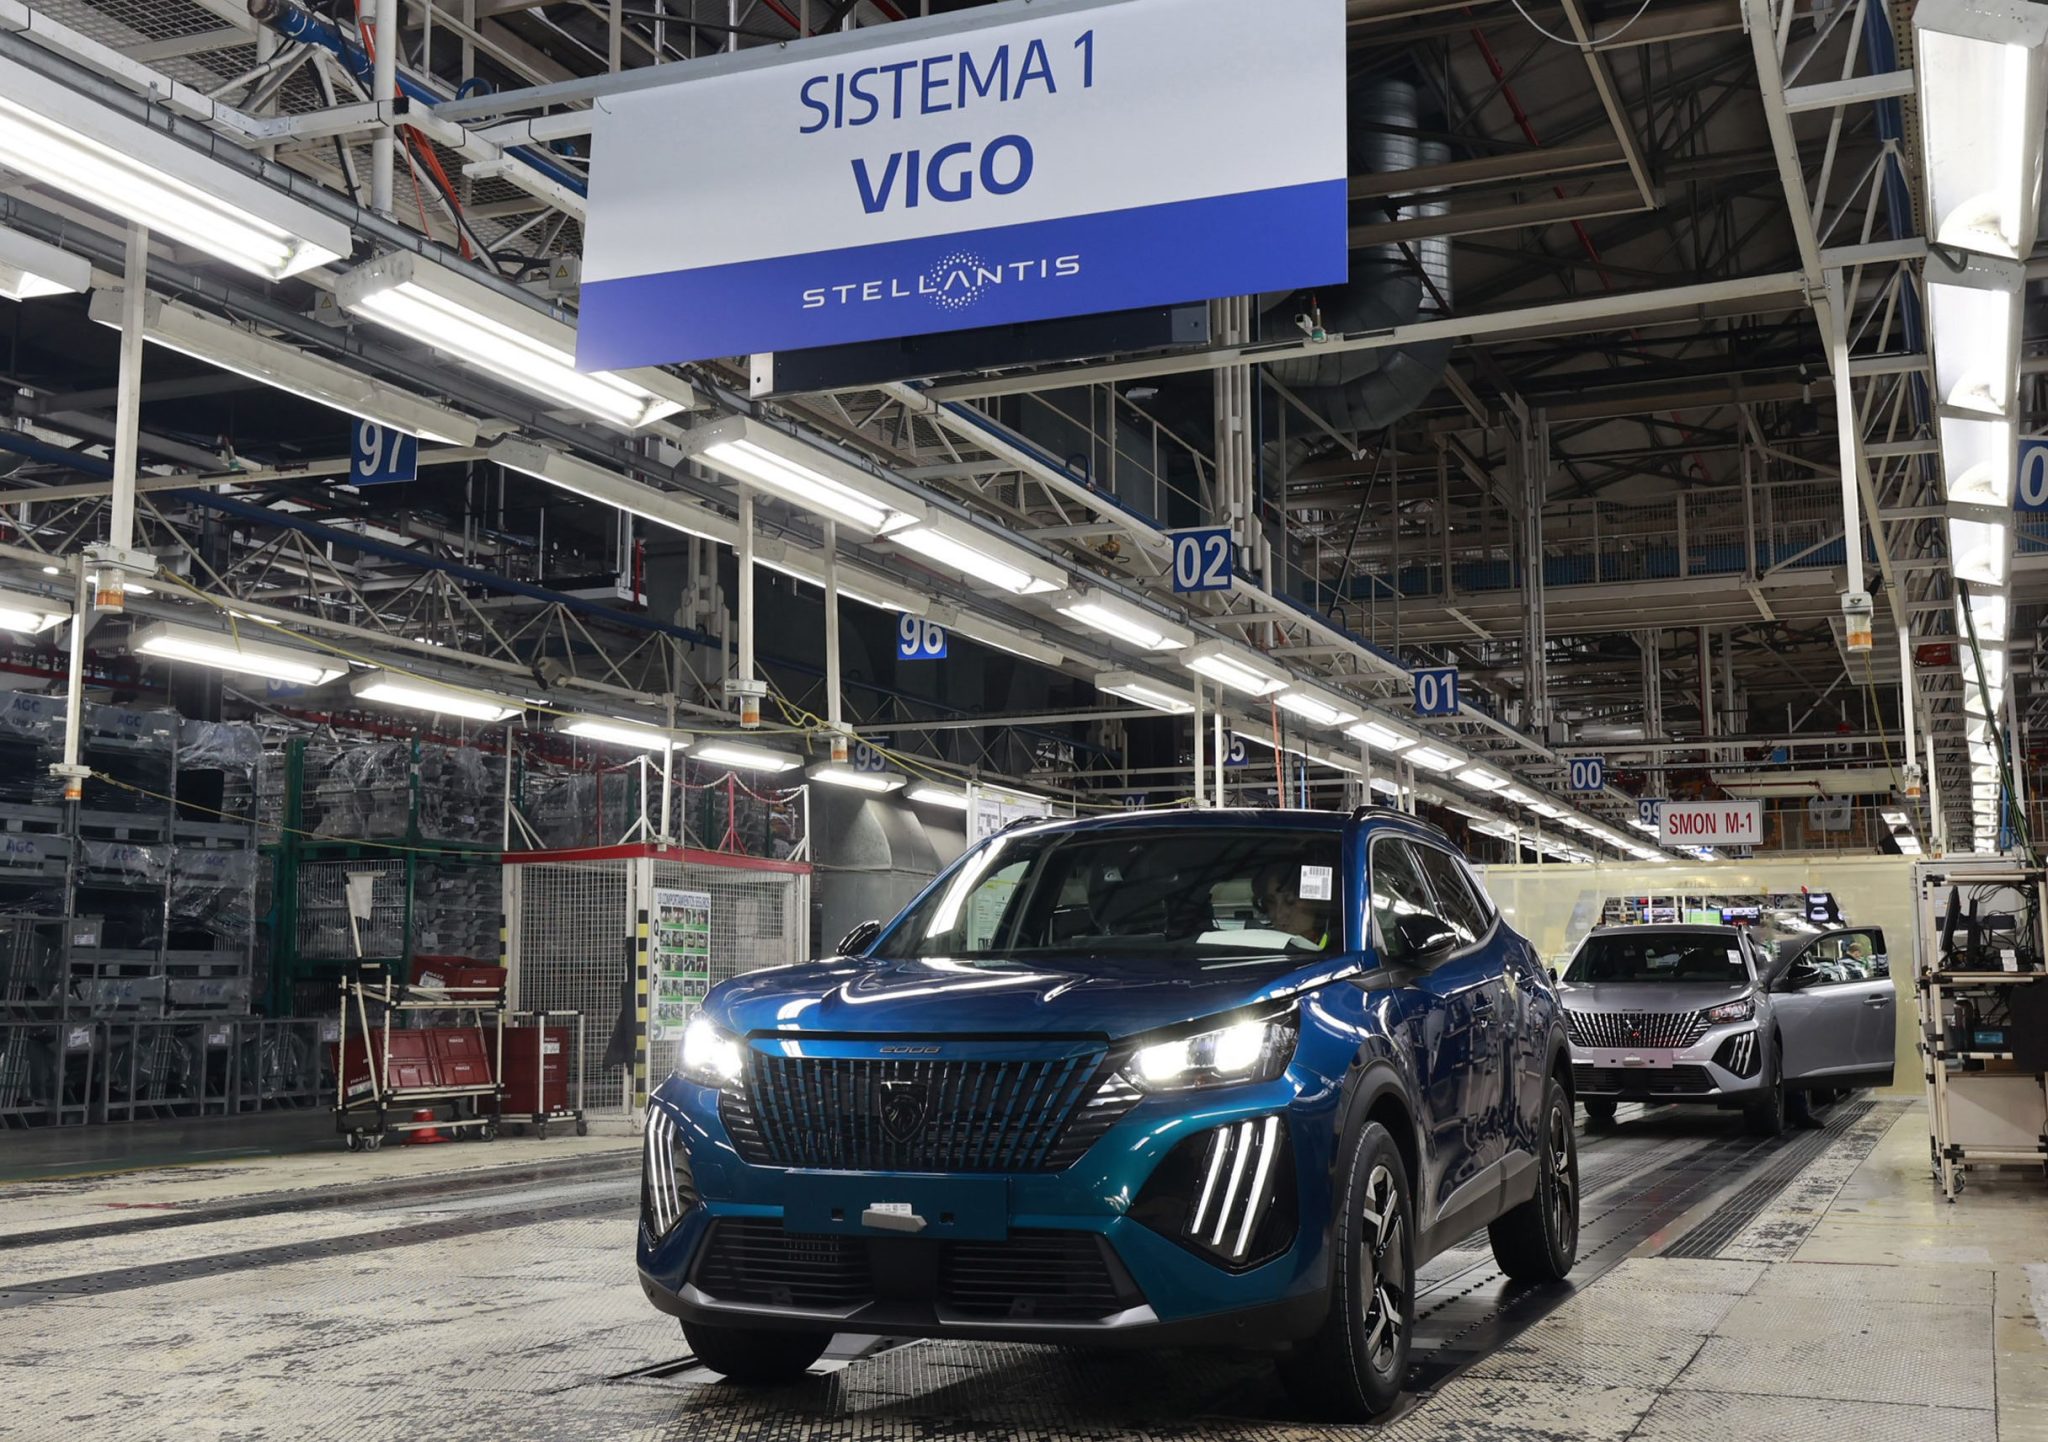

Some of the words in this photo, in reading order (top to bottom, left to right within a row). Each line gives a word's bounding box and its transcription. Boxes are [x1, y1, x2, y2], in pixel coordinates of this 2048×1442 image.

[800, 38, 1057, 134] SISTEMA
[1074, 29, 1093, 88] 1
[851, 134, 1034, 214] VIGO
[802, 254, 1080, 309] STELLANTIS
[359, 420, 404, 477] 97
[1176, 535, 1228, 588] 02
[901, 613, 944, 655] 96
[13, 698, 41, 713] AGC
[1419, 673, 1454, 710] 01
[117, 713, 142, 728] AGC
[856, 742, 885, 771] 95
[1572, 762, 1601, 789] 00
[1640, 801, 1660, 825] 99
[1669, 812, 1716, 835] SMON
[1725, 812, 1753, 834] M-1
[6, 839, 34, 853] AGC
